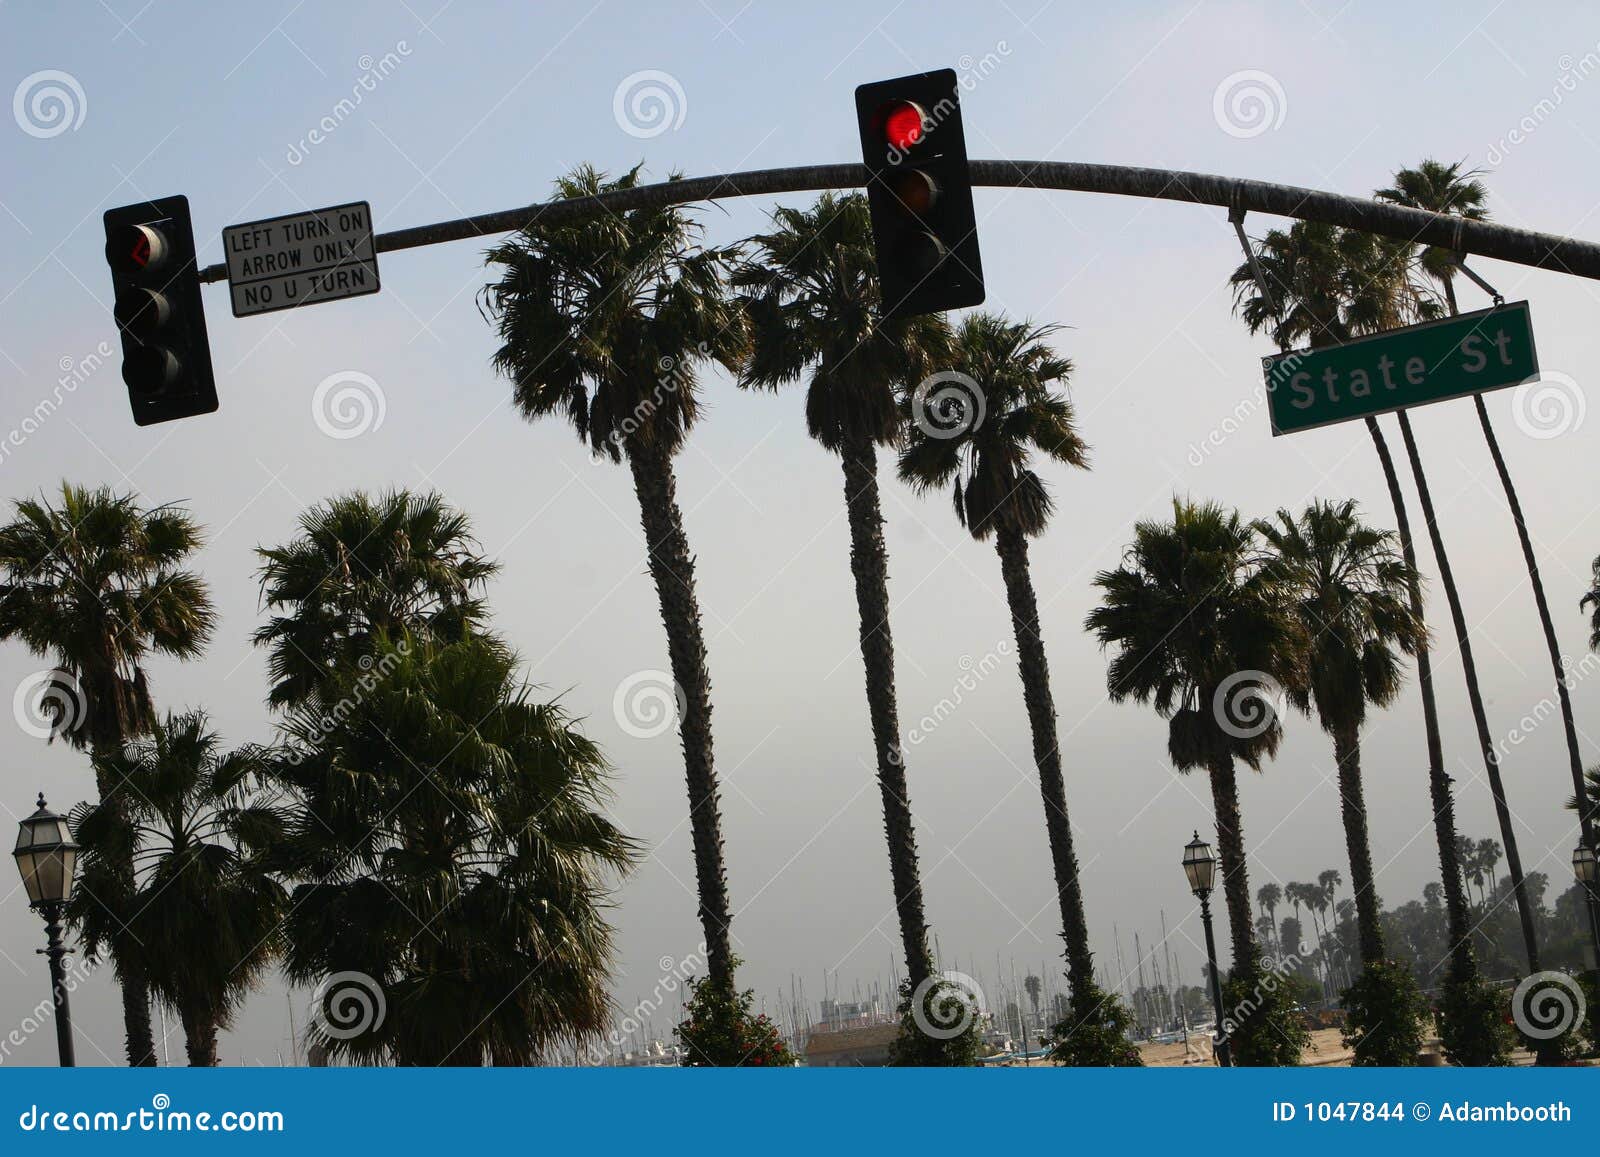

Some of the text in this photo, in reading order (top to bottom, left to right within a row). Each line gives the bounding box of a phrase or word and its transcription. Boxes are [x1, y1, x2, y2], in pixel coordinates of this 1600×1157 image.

[231, 211, 364, 253] LEFT TURN ON
[242, 238, 357, 277] ARROW ONLY
[244, 267, 365, 307] NO U TURN
[1289, 328, 1514, 409] State St
